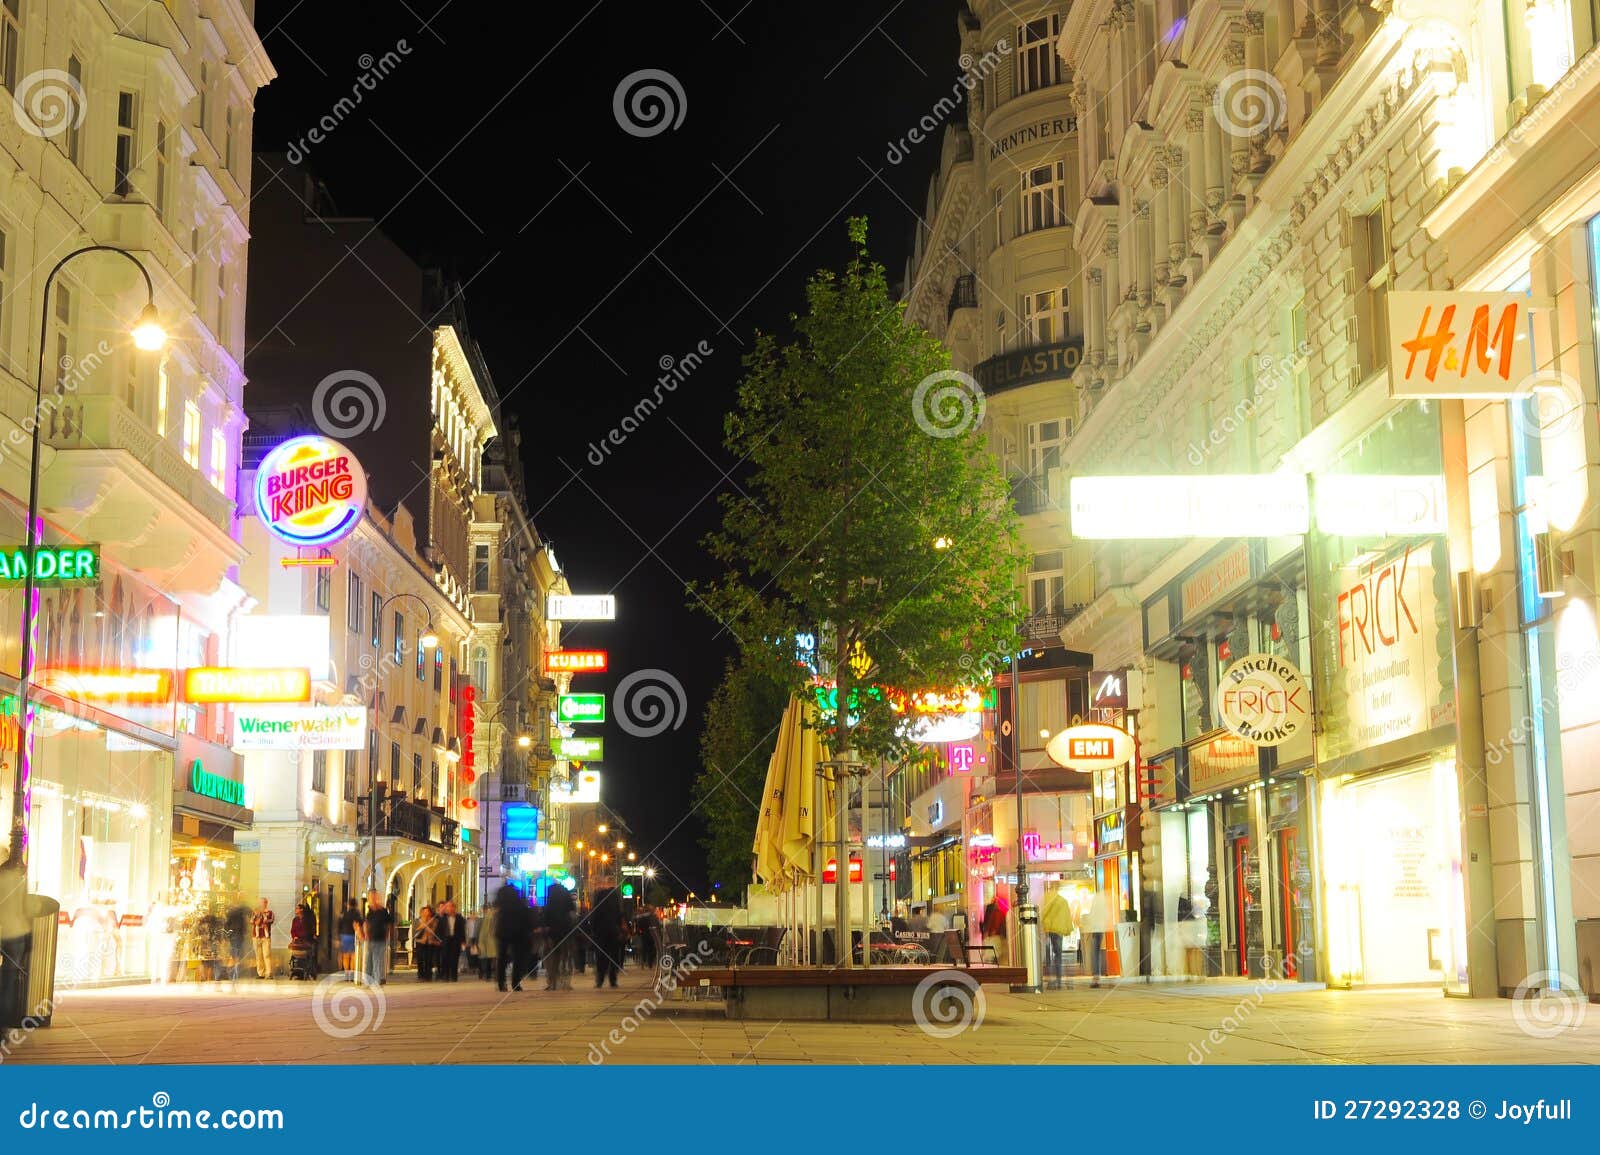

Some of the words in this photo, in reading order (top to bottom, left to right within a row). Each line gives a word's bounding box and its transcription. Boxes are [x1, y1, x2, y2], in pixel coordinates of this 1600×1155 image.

[1401, 302, 1518, 383] H&M
[267, 456, 349, 496] BURGER
[271, 474, 353, 522] KING
[549, 655, 604, 667] KURIER
[1229, 657, 1298, 685] Bücher
[1224, 687, 1306, 715] FRICK
[240, 715, 342, 733] Wienerwald
[1237, 721, 1297, 742] Books
[1074, 741, 1109, 755] EMI
